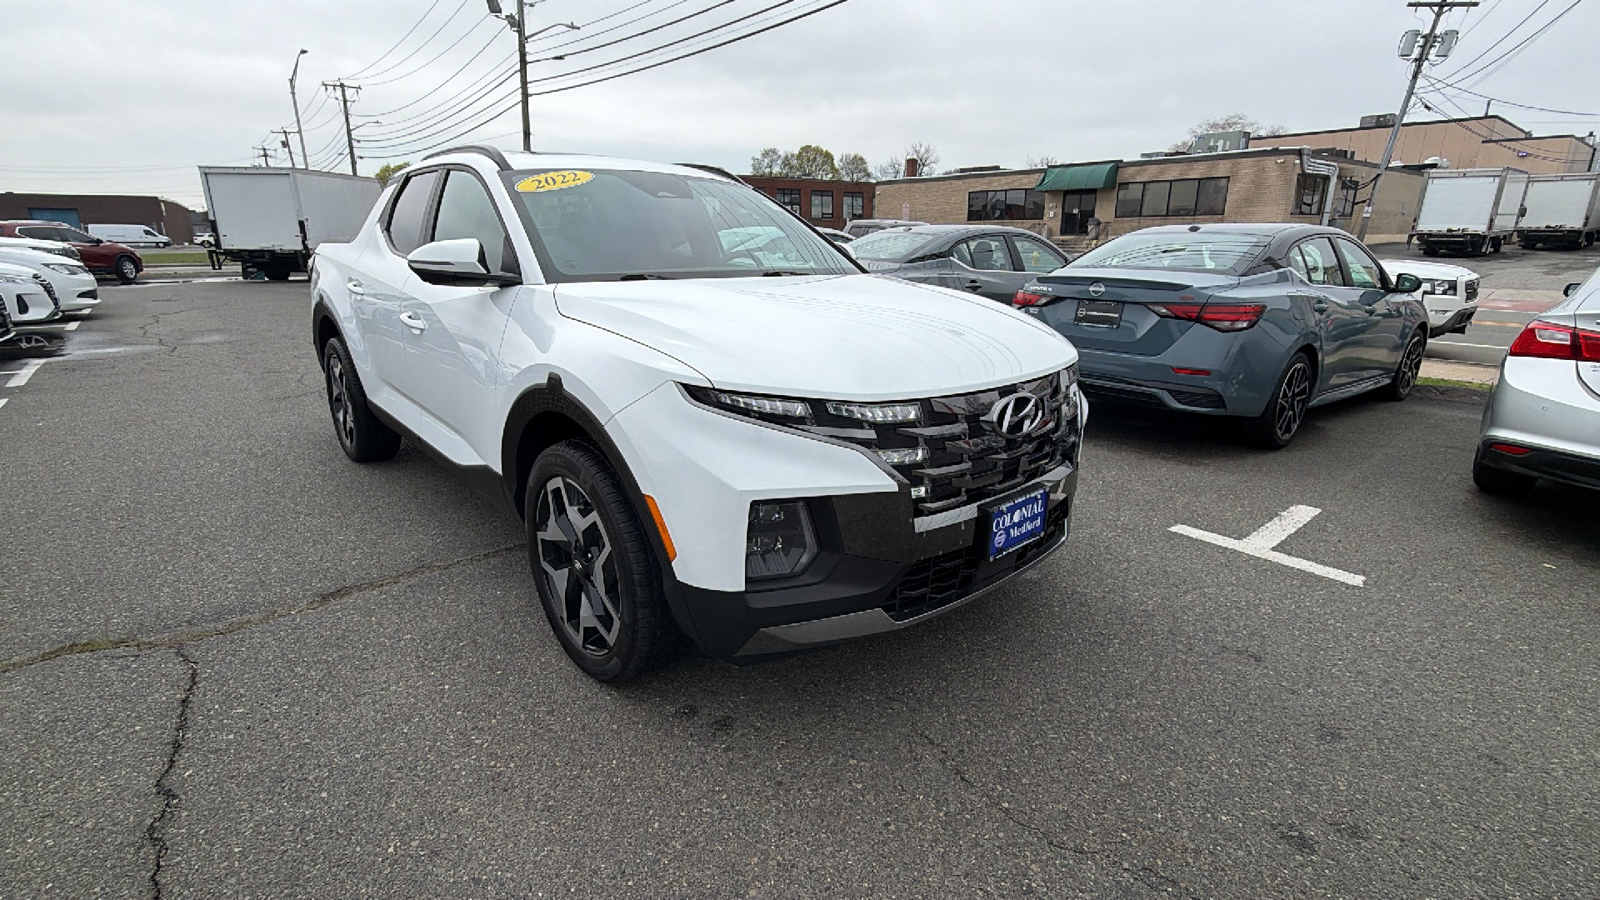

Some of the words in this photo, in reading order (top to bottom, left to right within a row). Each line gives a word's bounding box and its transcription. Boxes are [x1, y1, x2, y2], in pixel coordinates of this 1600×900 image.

[531, 172, 581, 190] 2022
[993, 500, 1044, 532] COLONIAL
[1009, 516, 1041, 539] Medford
